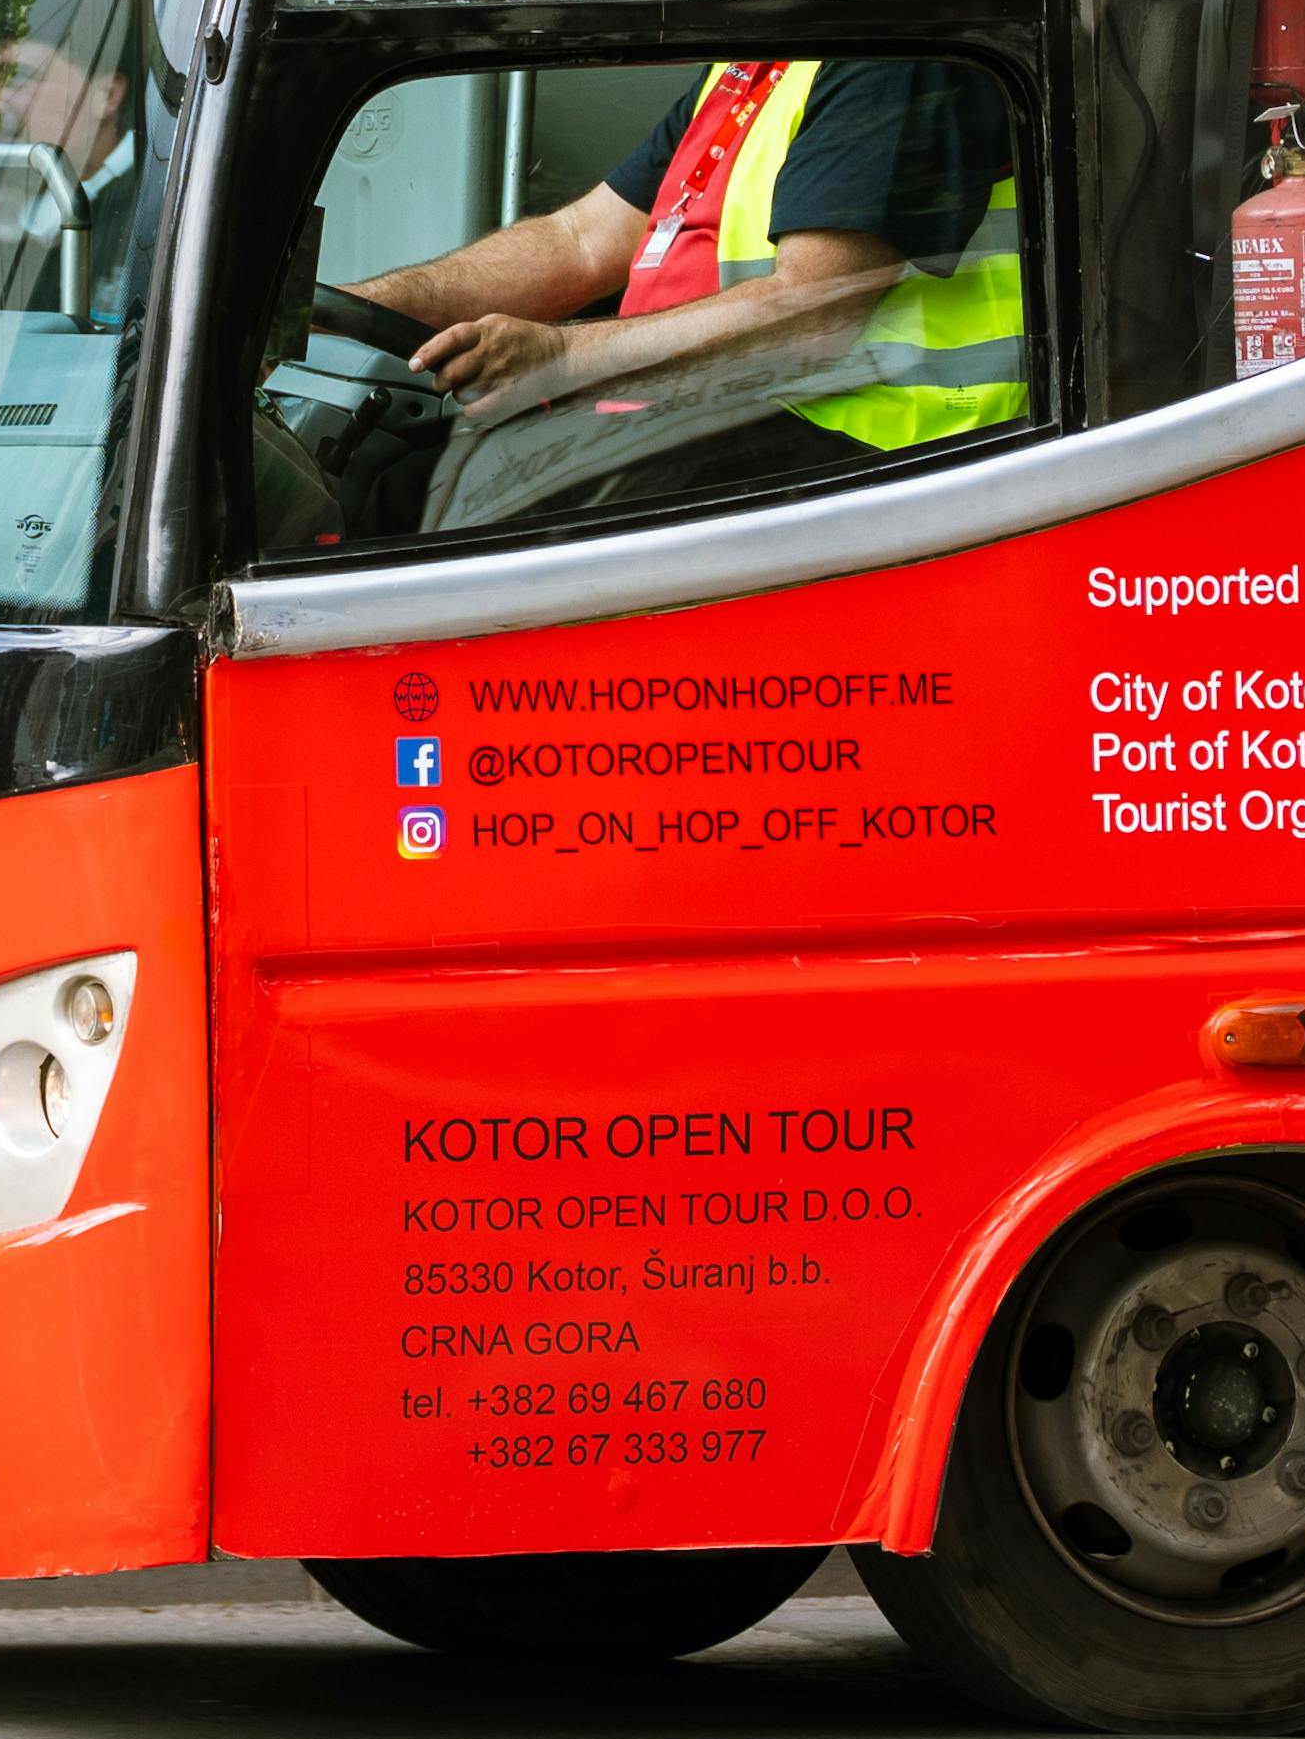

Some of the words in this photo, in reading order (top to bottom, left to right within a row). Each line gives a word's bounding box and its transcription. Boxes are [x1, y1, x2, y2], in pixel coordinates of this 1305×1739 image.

[1088, 564, 1299, 616] Supported
[469, 672, 953, 712] WWW.HOPONHOPOFF.ME
[1090, 672, 1169, 721] City
[1182, 670, 1223, 711] of
[468, 739, 861, 787] @KOTOROPENTOUR
[1092, 732, 1177, 772] Port
[1189, 729, 1230, 771] of
[473, 803, 997, 854] HOP_ON_HOP_OFF_KOTOR
[1092, 792, 1227, 834] Tourist
[404, 1116, 589, 1163] KOTOR
[606, 1112, 751, 1159] OPEN
[768, 1107, 916, 1154] TOUR
[404, 1197, 543, 1232] KOTOR
[556, 1194, 666, 1230] OPEN
[679, 1191, 789, 1226] TOUR
[803, 1185, 922, 1222] D.O.O.
[404, 1261, 514, 1296] 85330
[527, 1261, 627, 1294] Kotor,
[642, 1249, 755, 1295] Šuranj
[768, 1253, 831, 1286] b.b.
[401, 1324, 514, 1359] CRNA
[524, 1321, 640, 1355] GORA
[401, 1386, 451, 1419] tel.
[467, 1383, 556, 1417] +382
[567, 1382, 611, 1415] 69
[622, 1379, 690, 1413] 467
[702, 1377, 767, 1411] 680
[467, 1434, 555, 1469] +382
[567, 1433, 611, 1466] 67
[623, 1431, 689, 1465] 333
[701, 1429, 767, 1463] 977
